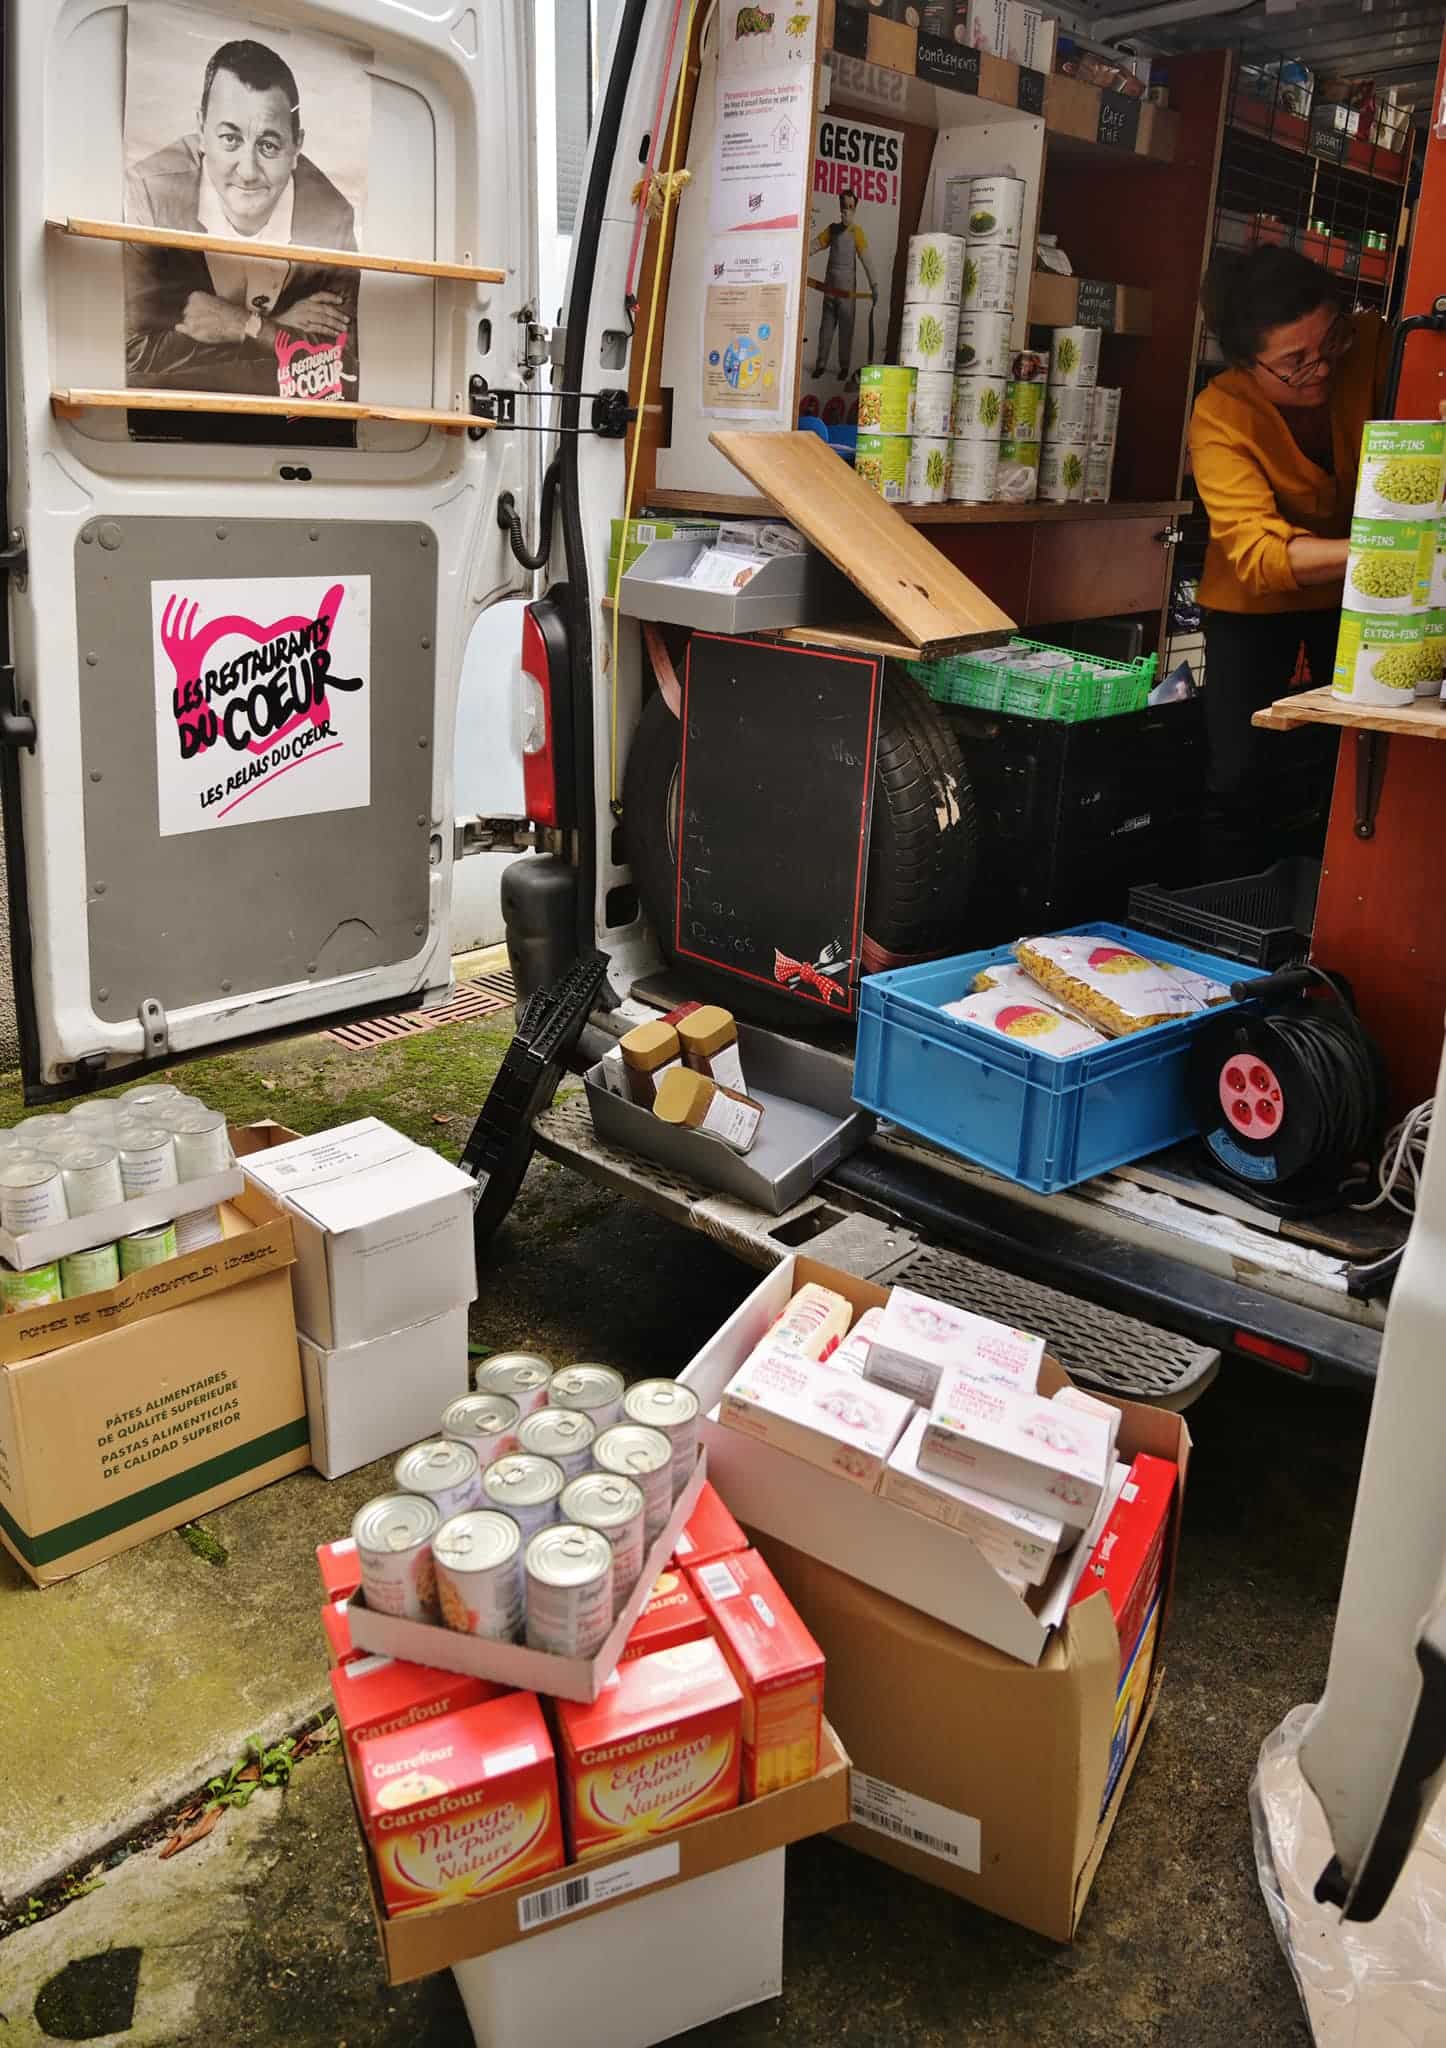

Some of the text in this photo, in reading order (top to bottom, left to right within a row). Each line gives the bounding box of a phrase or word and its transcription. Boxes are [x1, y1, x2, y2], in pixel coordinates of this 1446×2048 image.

[819, 122, 898, 171] GESTES
[277, 345, 342, 382] LES RESTAURANTS
[279, 378, 297, 397] DU
[1363, 627, 1419, 640] EXTRA-FINS
[173, 615, 330, 719] LES RESTAURANTS
[178, 708, 219, 759] DU
[200, 783, 224, 809] LES
[225, 755, 270, 796] RELAIS
[271, 743, 291, 767] DU
[145, 1369, 228, 1414] ALIMENTAIRES
[97, 1434, 114, 1448] DE
[117, 1409, 169, 1439] QUALITÉ
[101, 1397, 240, 1465] PASTAS ALIMENTICIAS
[102, 1411, 242, 1480] DE CALIDAD SUPERIOR
[351, 1697, 451, 1745] Carrefour
[371, 1744, 455, 1780] Carrefour
[578, 1726, 680, 1766] Carrefour
[377, 1789, 485, 1831] Carrefour
[415, 1801, 517, 1858] Mange
[436, 1839, 514, 1886] Nature
